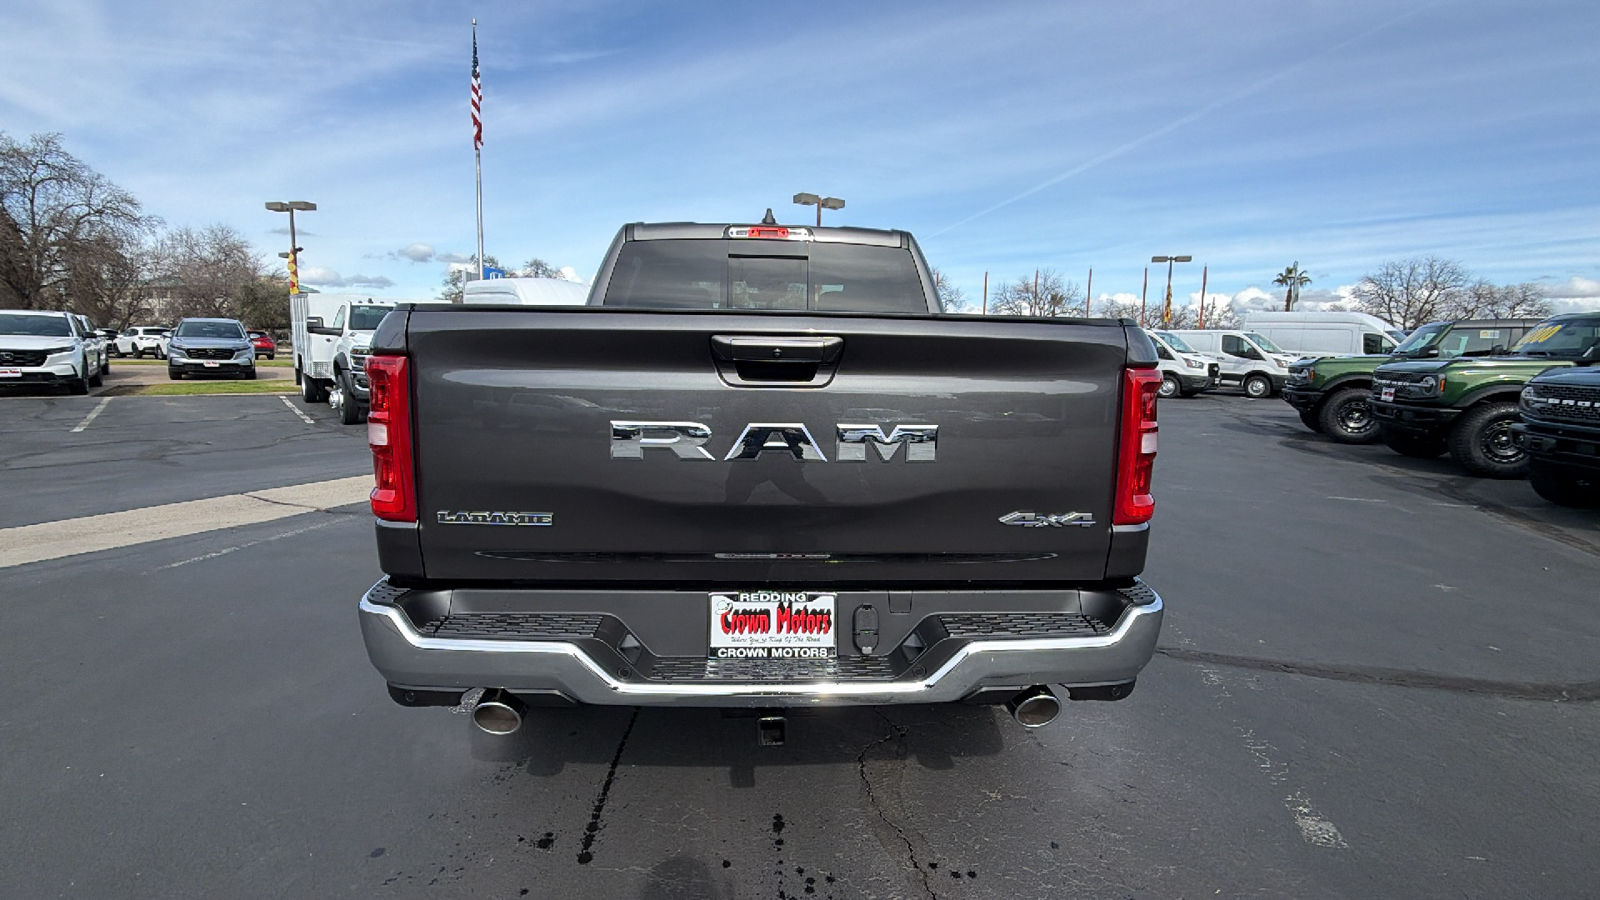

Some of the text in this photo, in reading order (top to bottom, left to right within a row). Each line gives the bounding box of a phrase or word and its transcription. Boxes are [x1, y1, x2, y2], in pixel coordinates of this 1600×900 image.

[609, 420, 939, 463] RAM
[436, 509, 554, 526] LARAMIE
[739, 592, 808, 602] REDDING
[719, 603, 832, 635] Crown Motors
[717, 647, 829, 658] CROWN MOTORS
